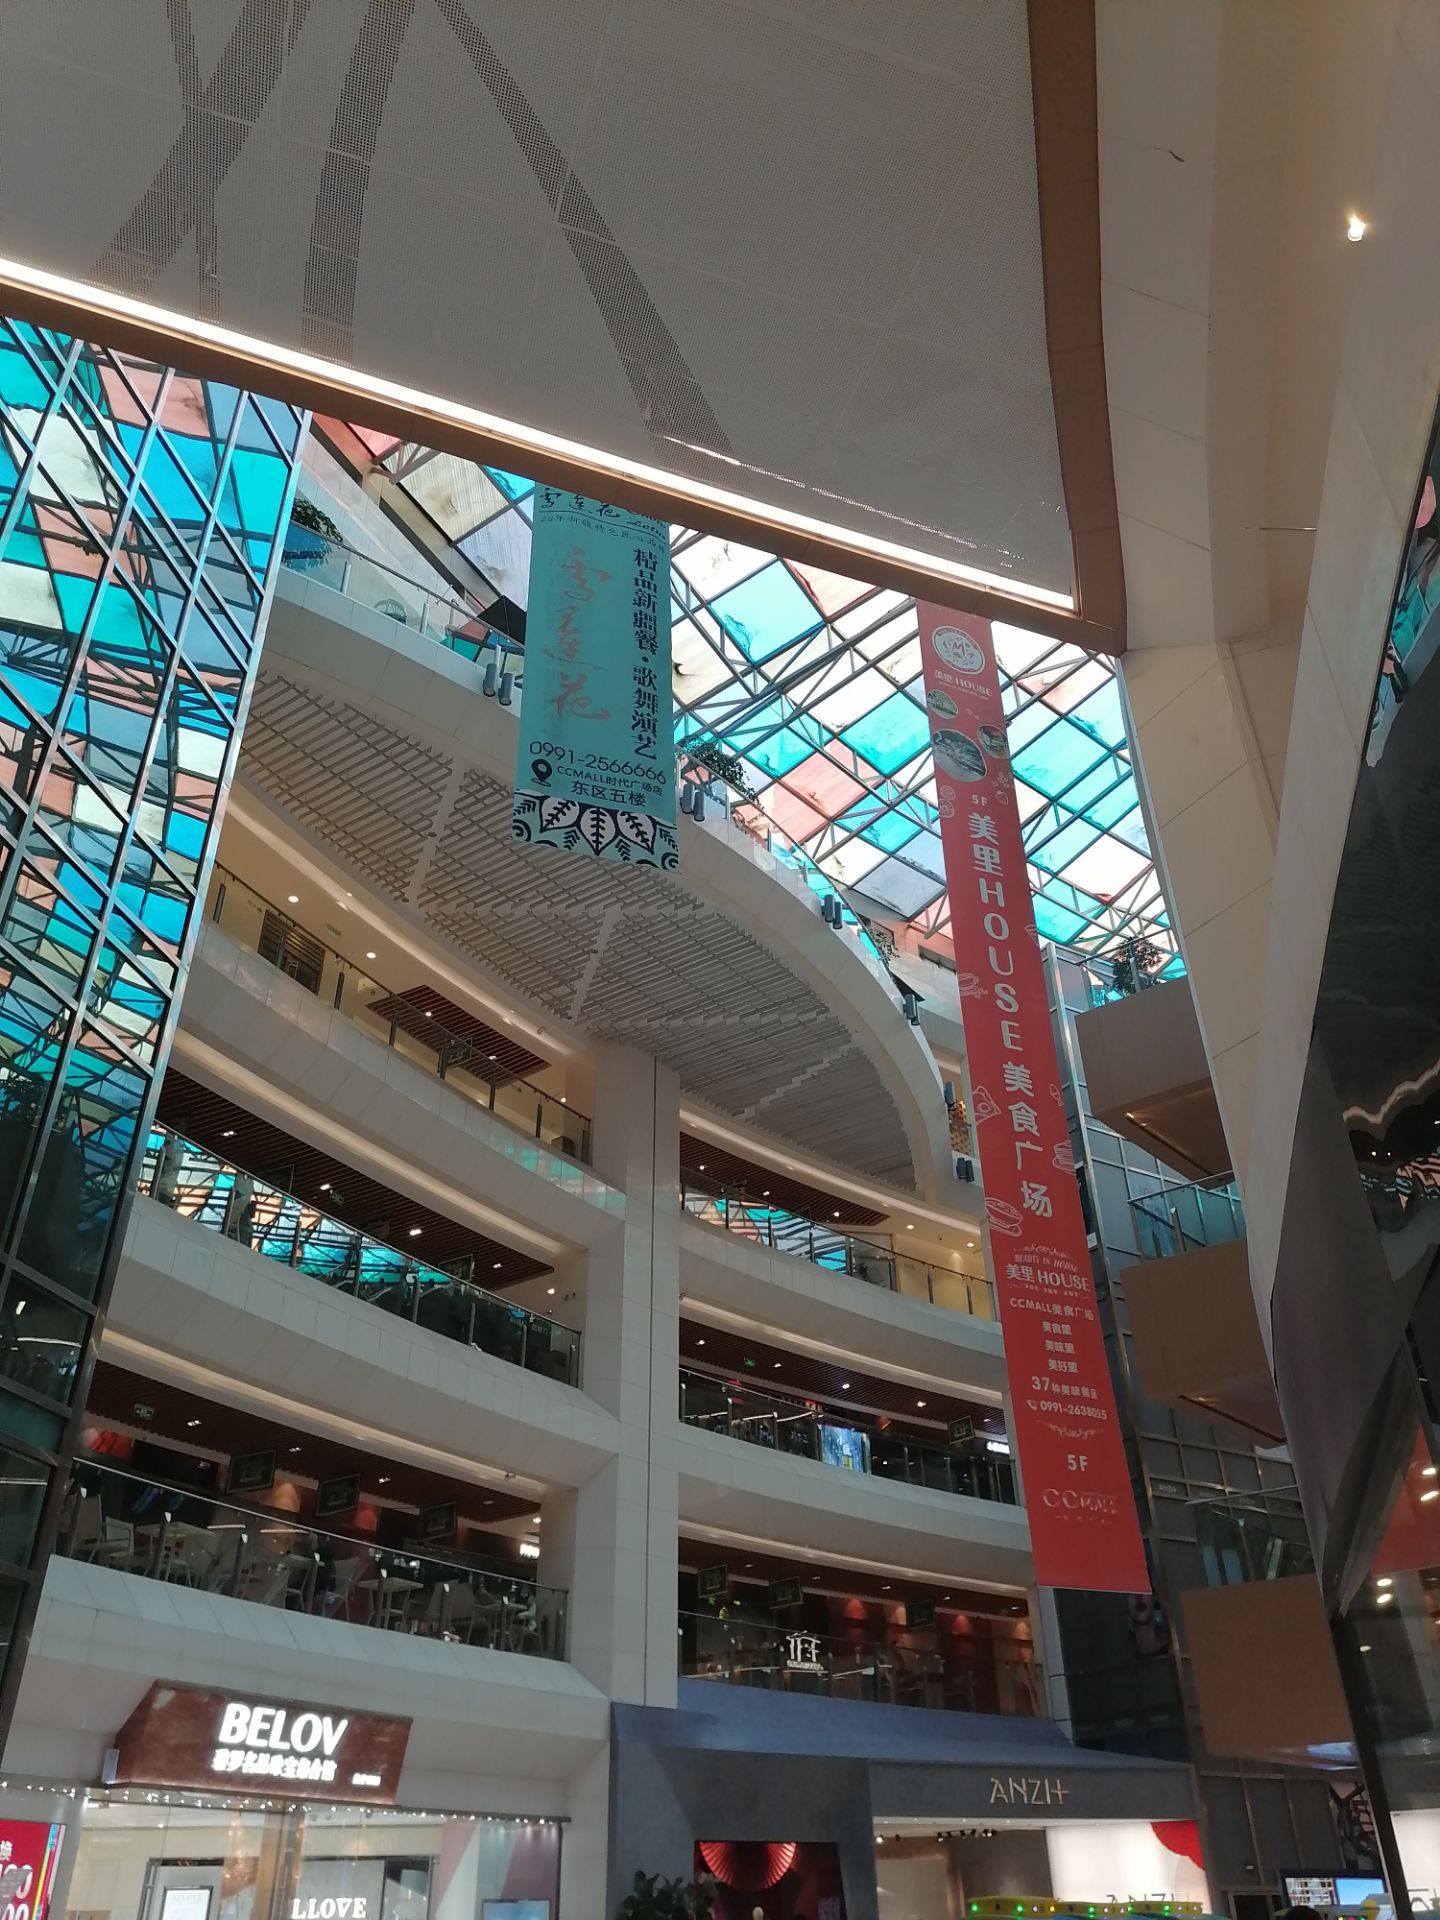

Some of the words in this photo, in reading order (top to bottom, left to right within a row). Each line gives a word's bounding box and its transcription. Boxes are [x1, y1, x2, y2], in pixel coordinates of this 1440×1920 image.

[529, 741, 667, 785] 0991-2566666
[571, 781, 646, 808] 东区五楼
[971, 794, 988, 807] 5F
[1005, 1263, 1035, 1283] 美里
[1037, 1269, 1091, 1292] HOUSE
[218, 1702, 349, 1756] BELOV
